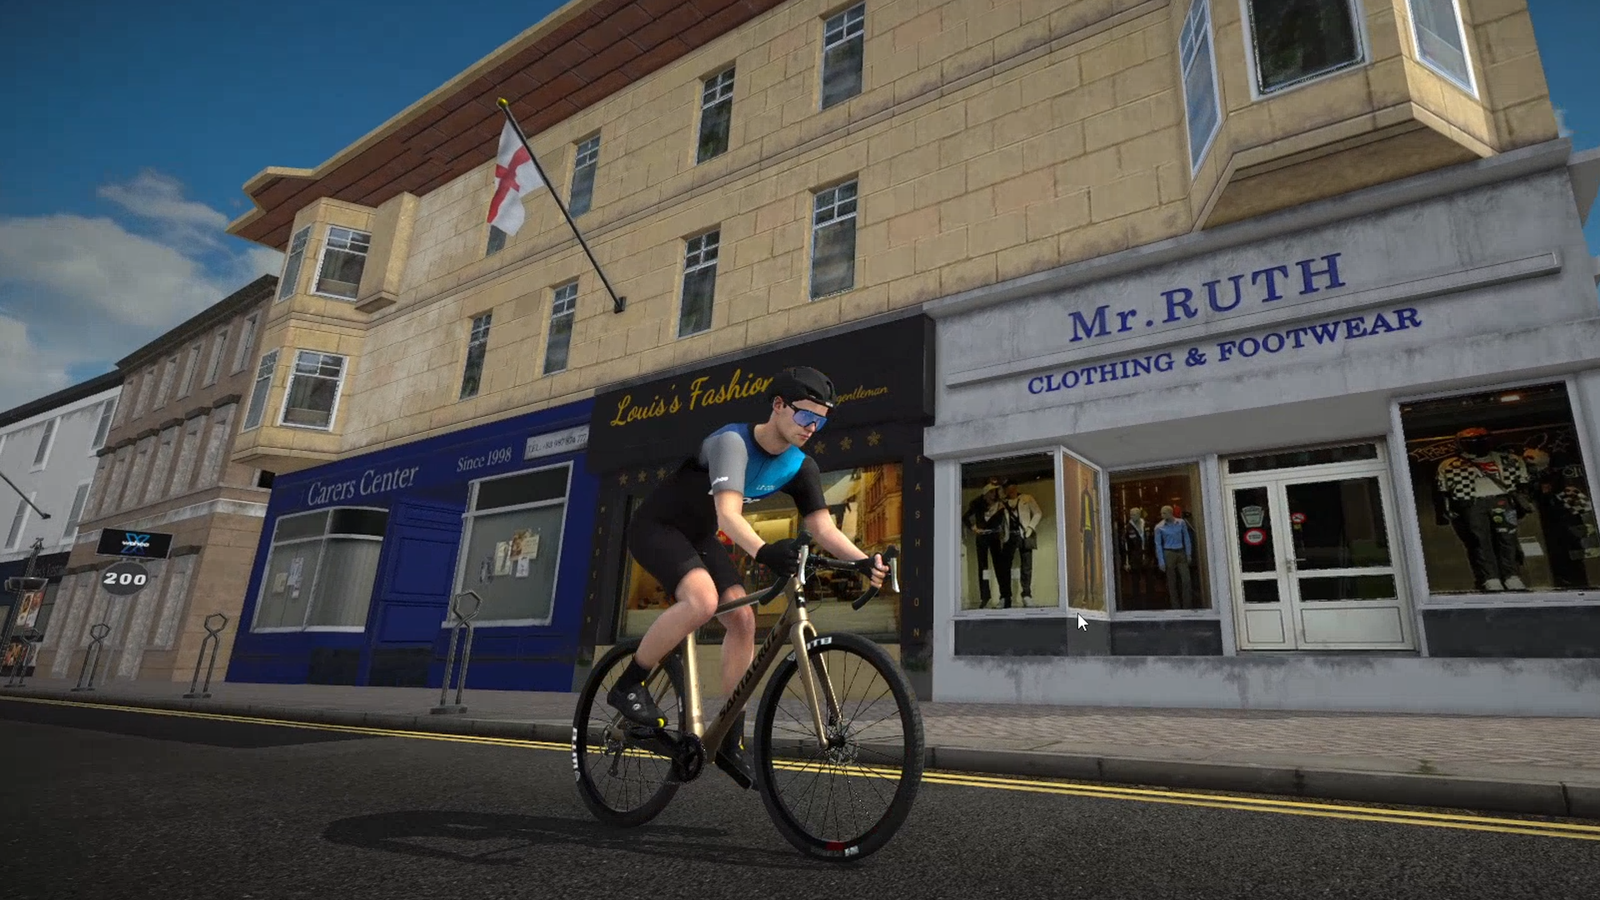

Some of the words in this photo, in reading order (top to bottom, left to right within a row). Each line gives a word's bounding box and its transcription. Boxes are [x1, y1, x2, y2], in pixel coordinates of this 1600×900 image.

[1027, 352, 1175, 394] CLOTHING
[1185, 347, 1207, 367] &
[1217, 307, 1422, 362] FOOTWEAR
[610, 384, 683, 426] Louis's
[836, 384, 889, 406] gentleman
[456, 456, 485, 472] Since
[487, 446, 513, 466] 1998
[307, 481, 356, 506] Carers
[360, 465, 419, 496] Center
[103, 572, 147, 586] 200
